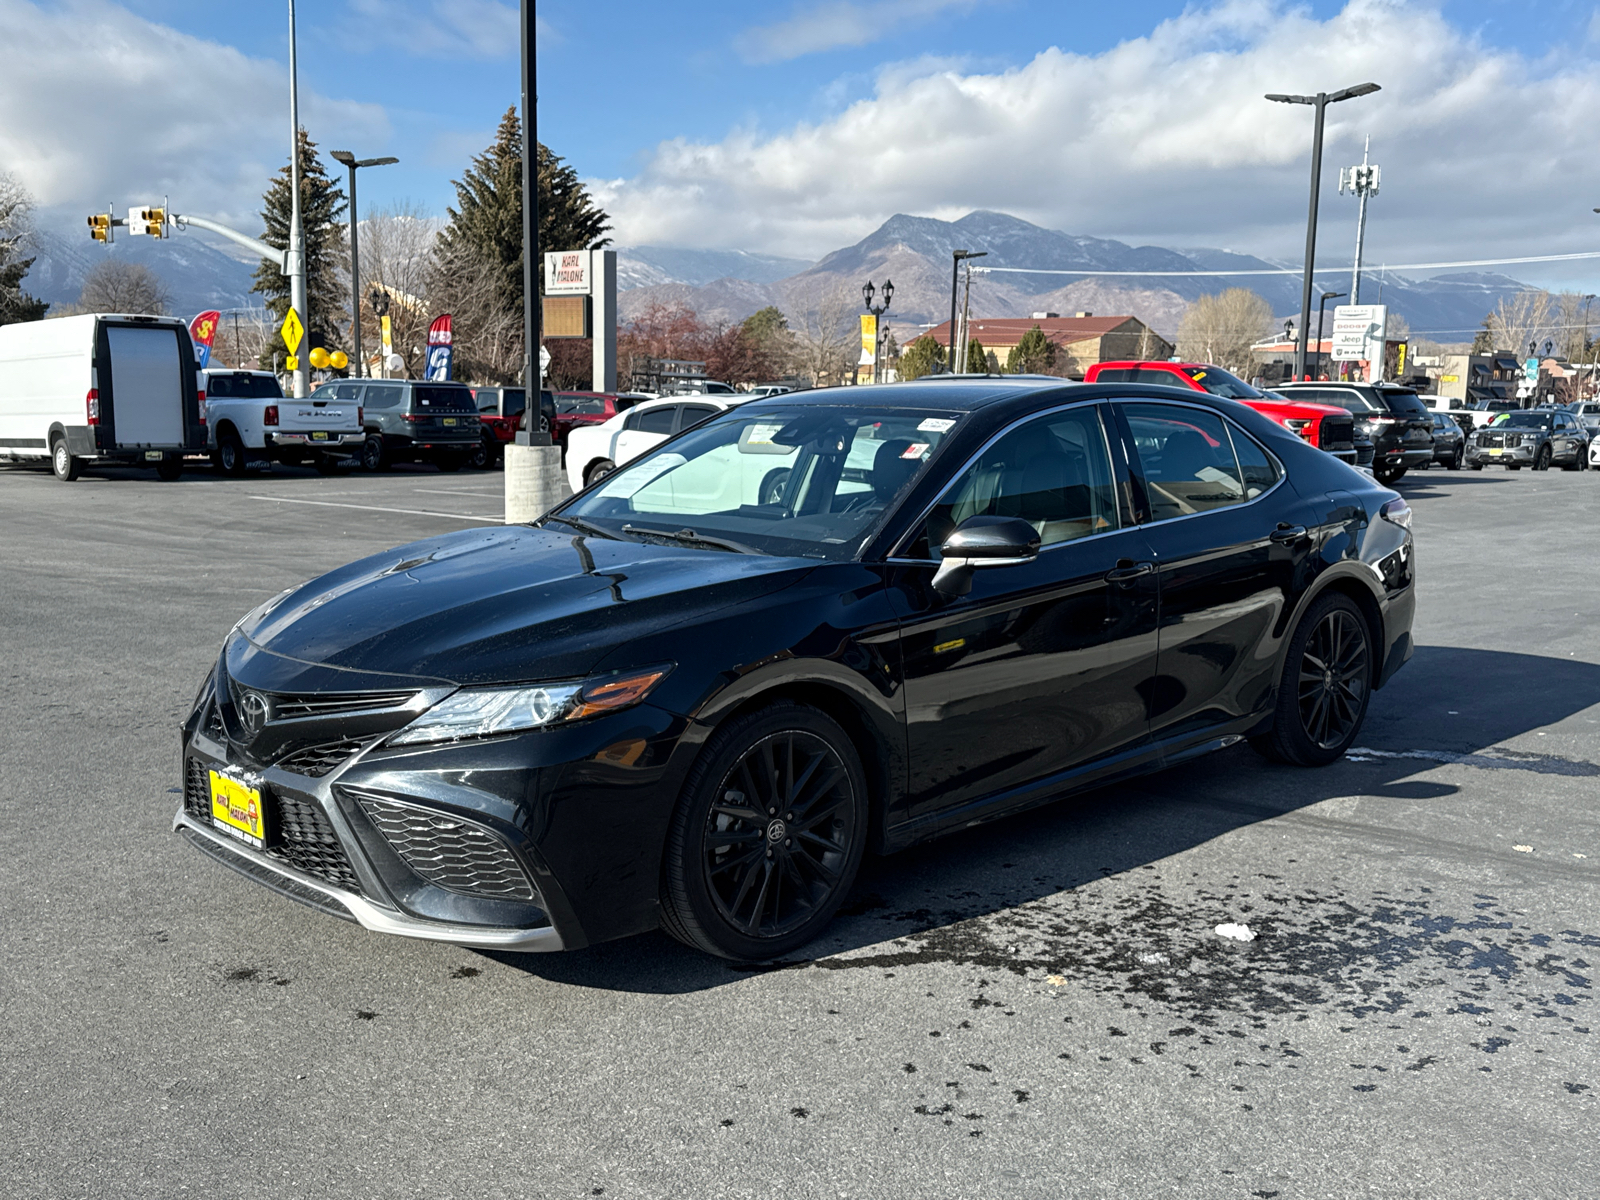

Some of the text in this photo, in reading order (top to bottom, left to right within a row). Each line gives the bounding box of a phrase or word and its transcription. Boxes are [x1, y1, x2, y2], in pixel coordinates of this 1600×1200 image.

[561, 254, 579, 268] KARL
[556, 269, 584, 282] MALONE
[429, 330, 452, 344] USED
[1341, 335, 1361, 344] Jeep
